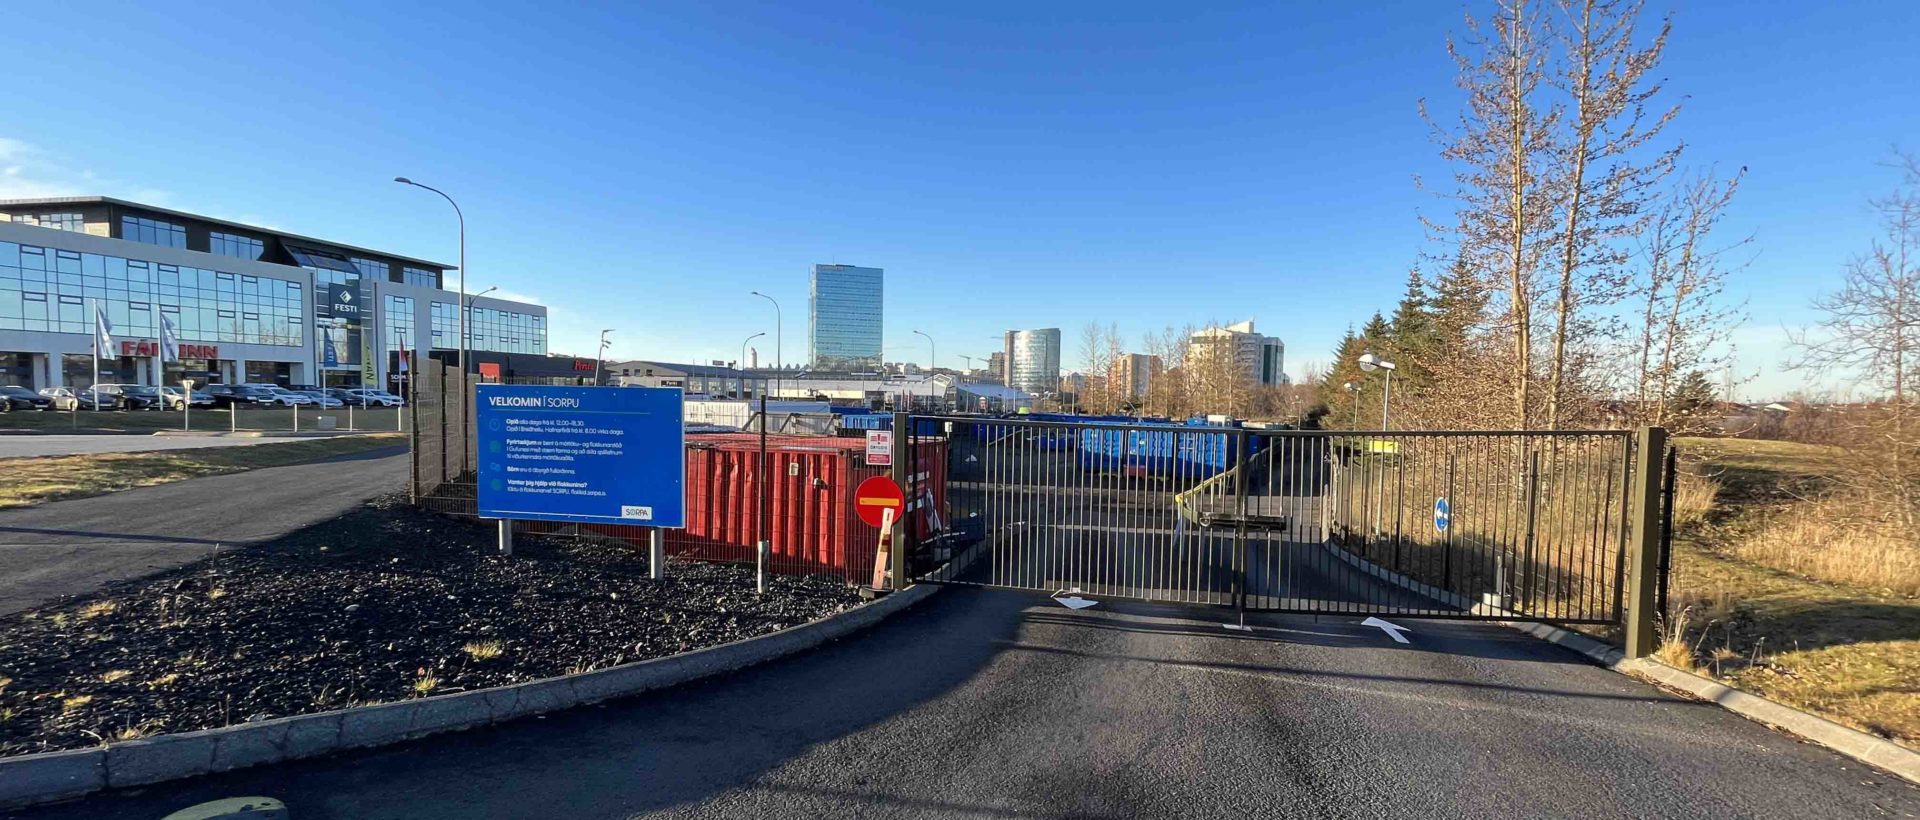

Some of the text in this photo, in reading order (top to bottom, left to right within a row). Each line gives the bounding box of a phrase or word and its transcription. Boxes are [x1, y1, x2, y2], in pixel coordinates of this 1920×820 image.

[334, 303, 358, 313] FESTI
[488, 395, 580, 408] VELKOMIN Í SORPU
[625, 508, 649, 517] SORPA
